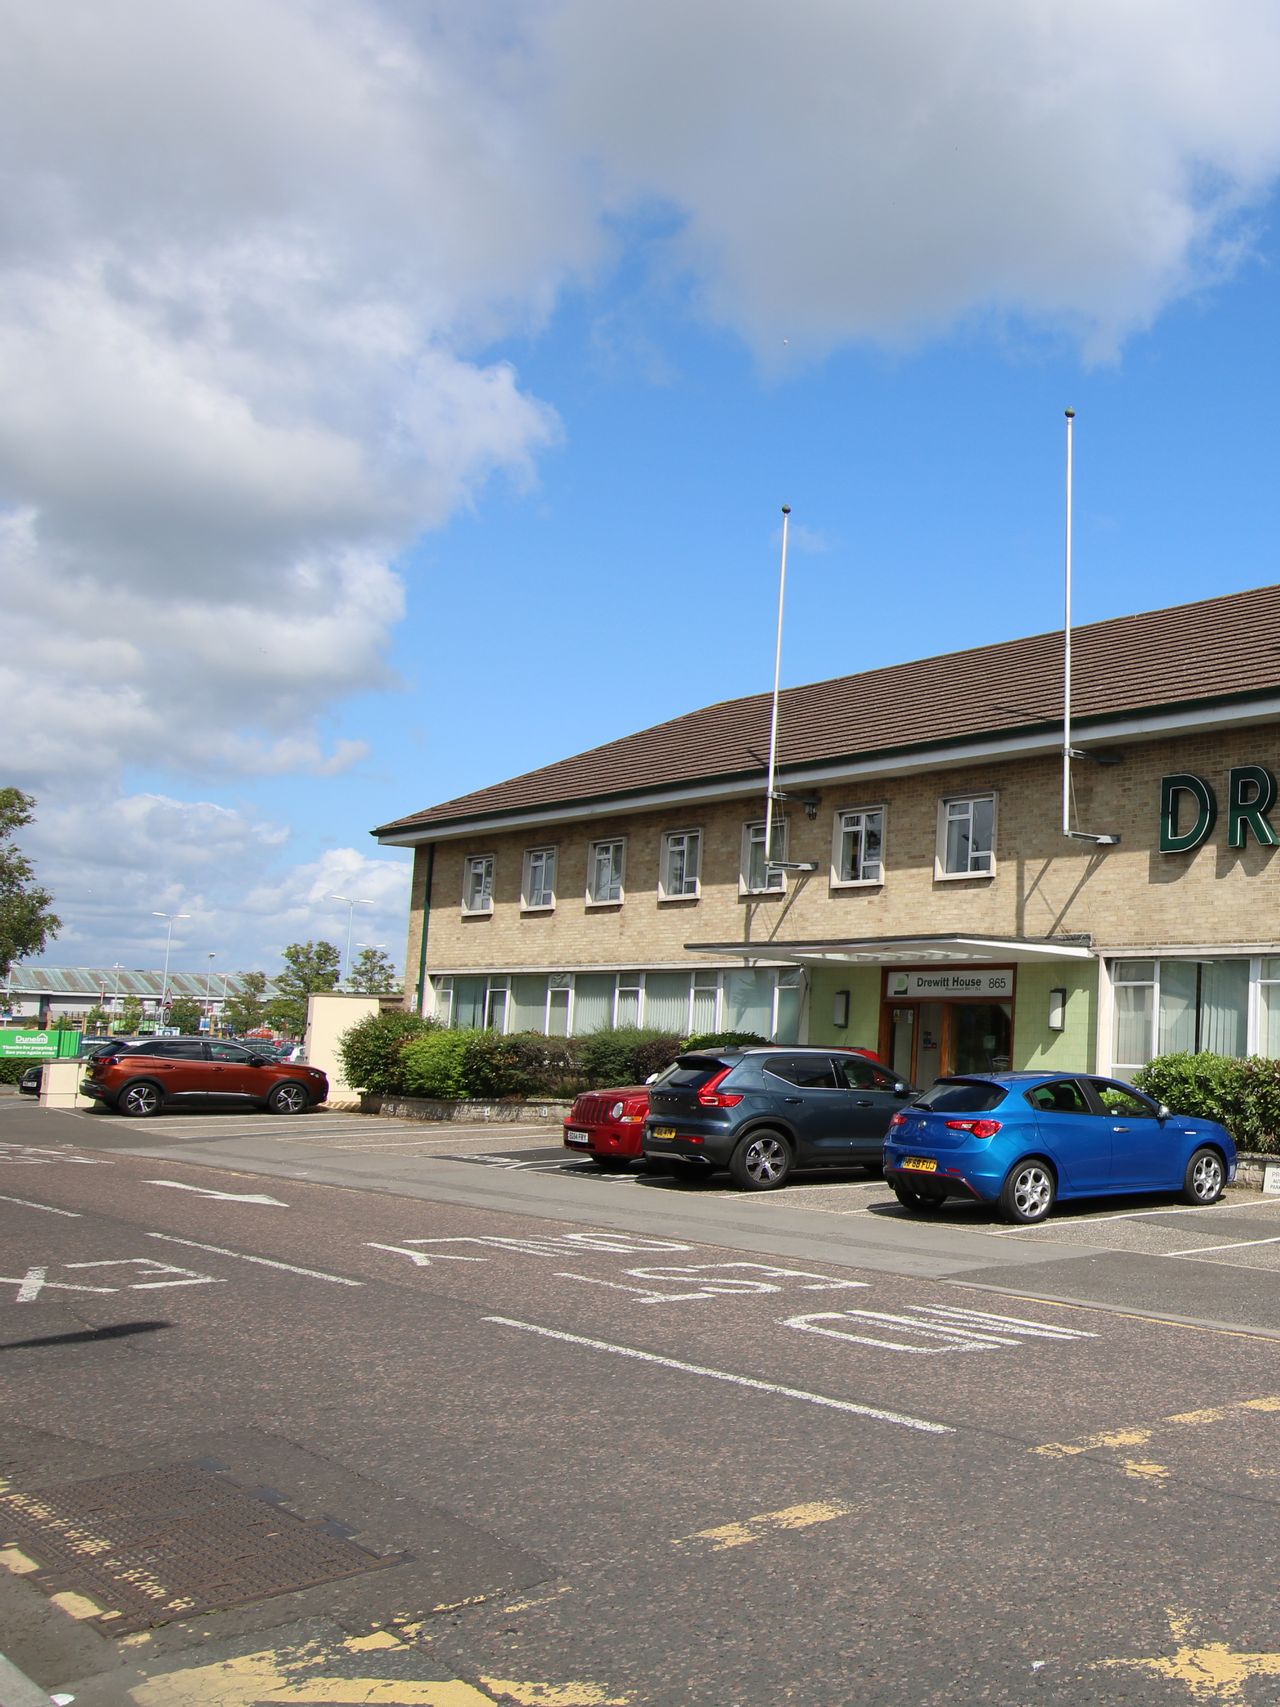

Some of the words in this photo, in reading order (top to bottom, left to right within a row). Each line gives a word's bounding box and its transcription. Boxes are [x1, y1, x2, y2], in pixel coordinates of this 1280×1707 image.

[917, 977, 949, 987] Drewitt
[952, 976, 982, 987] House
[988, 977, 1006, 989] 865
[15, 1033, 48, 1044] Dunelm
